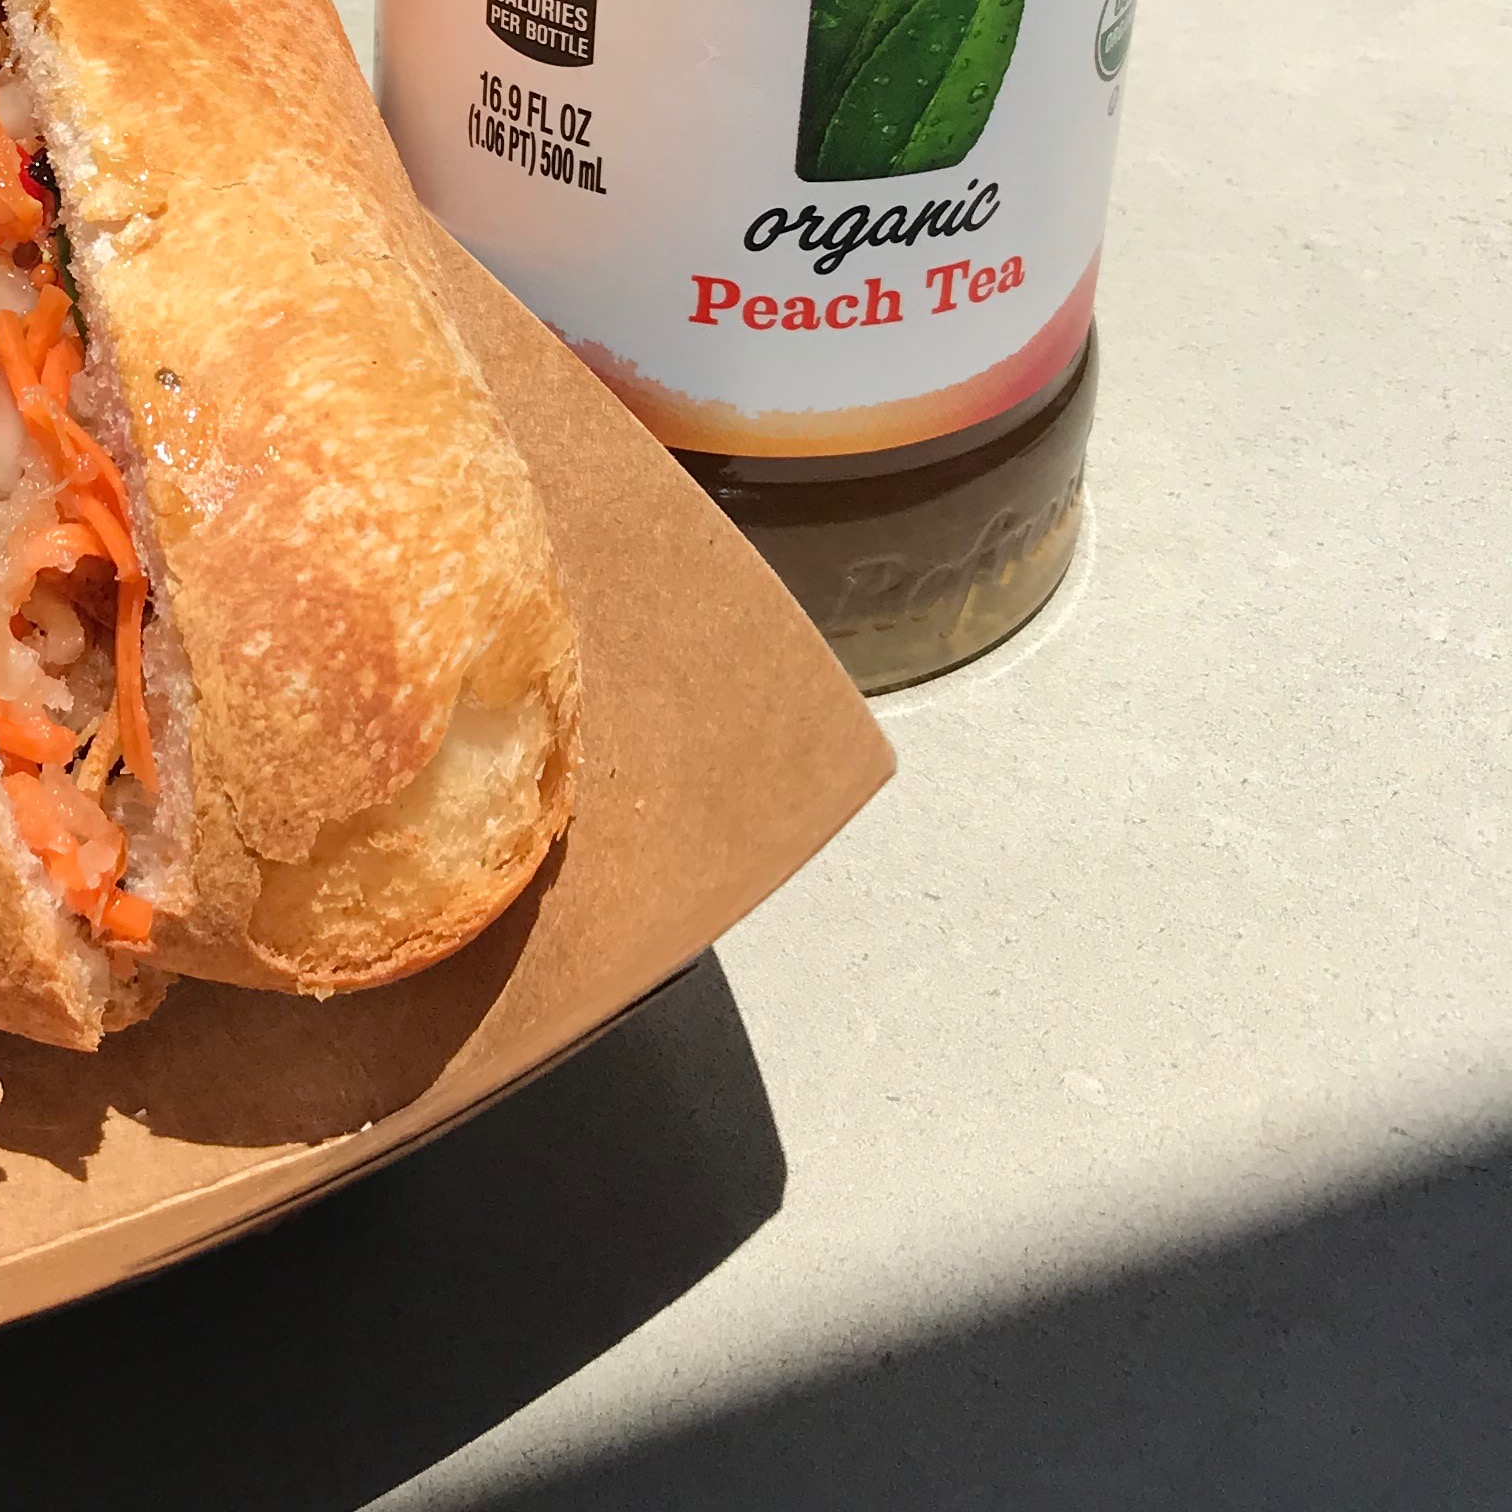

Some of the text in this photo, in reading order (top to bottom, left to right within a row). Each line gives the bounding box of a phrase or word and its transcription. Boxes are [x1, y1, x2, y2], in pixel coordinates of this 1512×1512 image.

[491, 4, 589, 59] PER BOTTLE
[480, 71, 593, 148] 16.9 FL OZ
[468, 103, 607, 195] (1.06 PT) 500 mL
[743, 178, 1001, 275] organic
[688, 255, 1026, 331] Peach Tea
